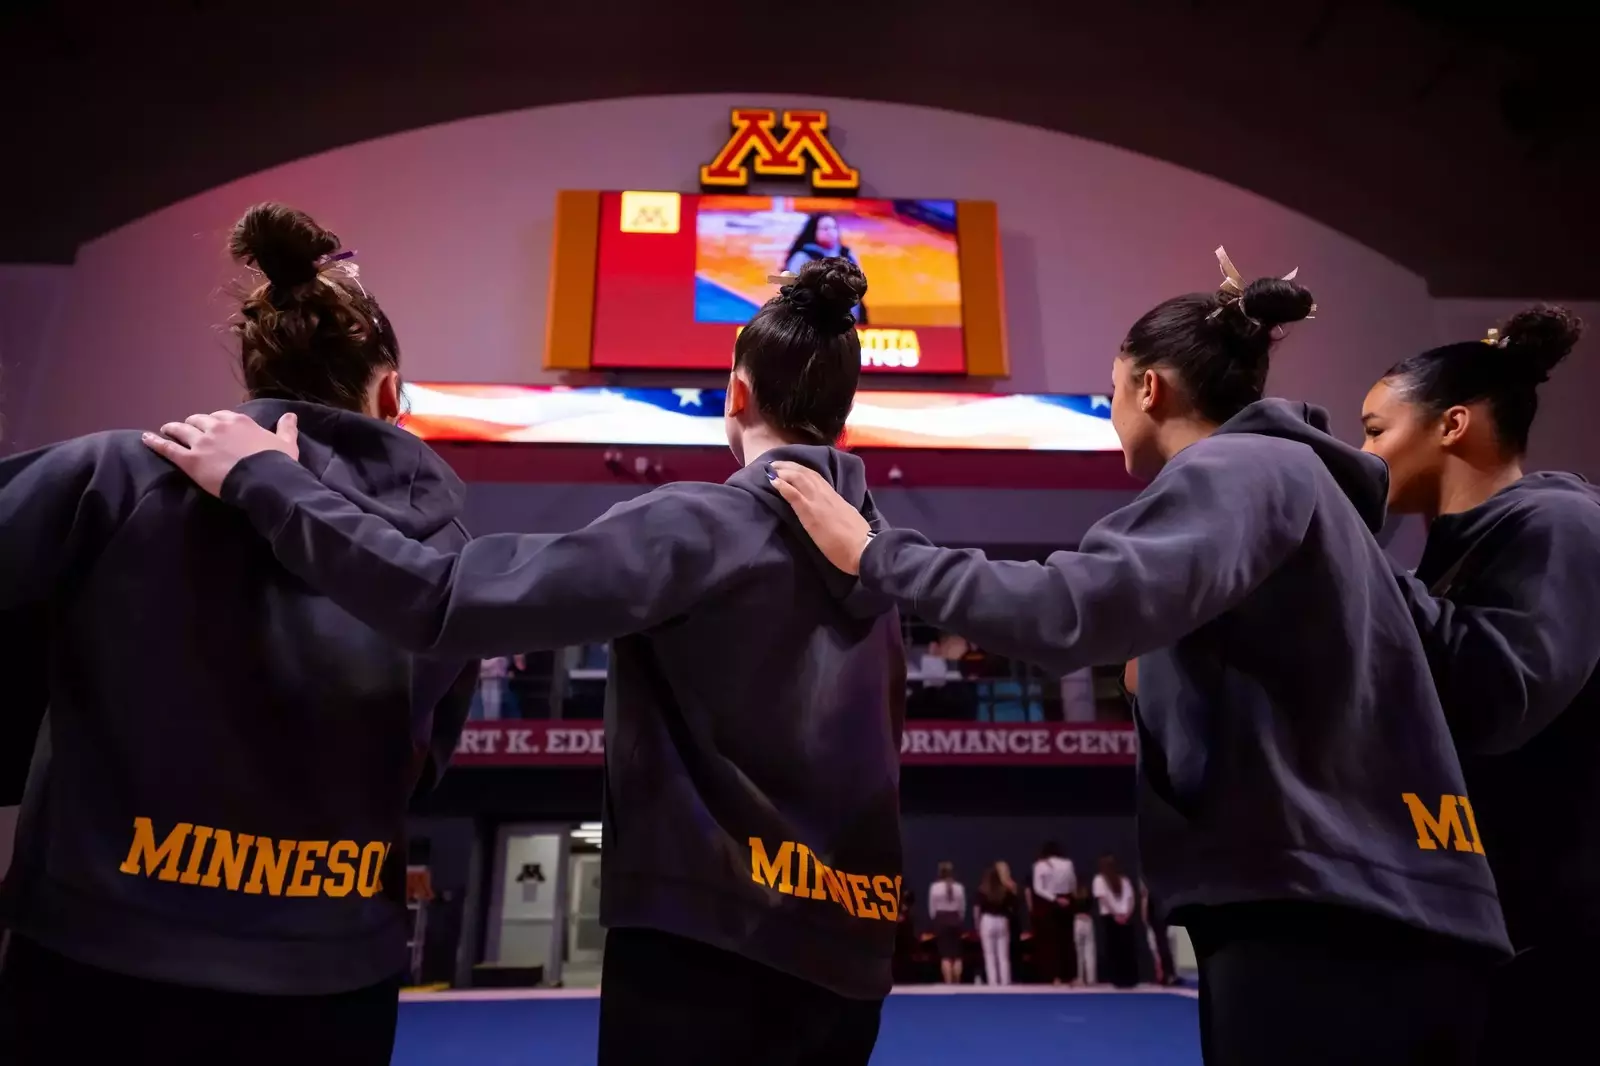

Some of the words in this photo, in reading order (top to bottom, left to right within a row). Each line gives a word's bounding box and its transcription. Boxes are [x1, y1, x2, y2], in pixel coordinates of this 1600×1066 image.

[700, 109, 859, 189] M
[505, 729, 539, 754] K.
[119, 816, 391, 897] MINNESO
[1401, 792, 1485, 856] MI
[749, 837, 902, 921] MINNES
